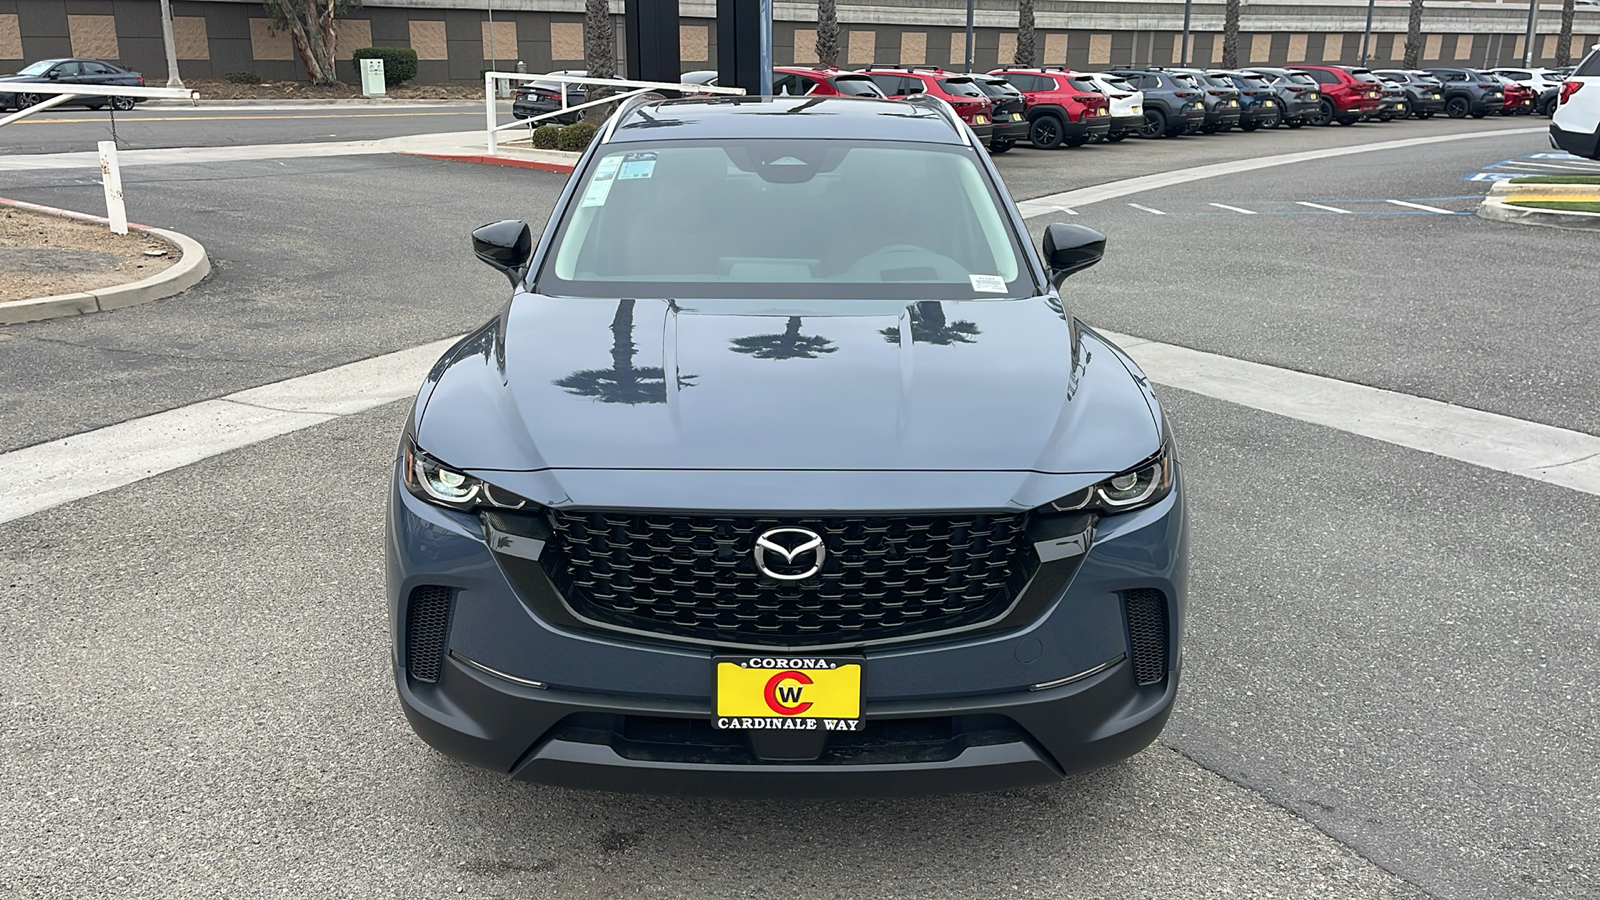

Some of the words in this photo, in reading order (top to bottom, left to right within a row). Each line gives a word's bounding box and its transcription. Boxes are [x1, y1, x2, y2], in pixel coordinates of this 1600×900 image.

[749, 658, 829, 669] CORONA
[717, 718, 817, 730] CARDINALE
[823, 719, 860, 731] WAY
